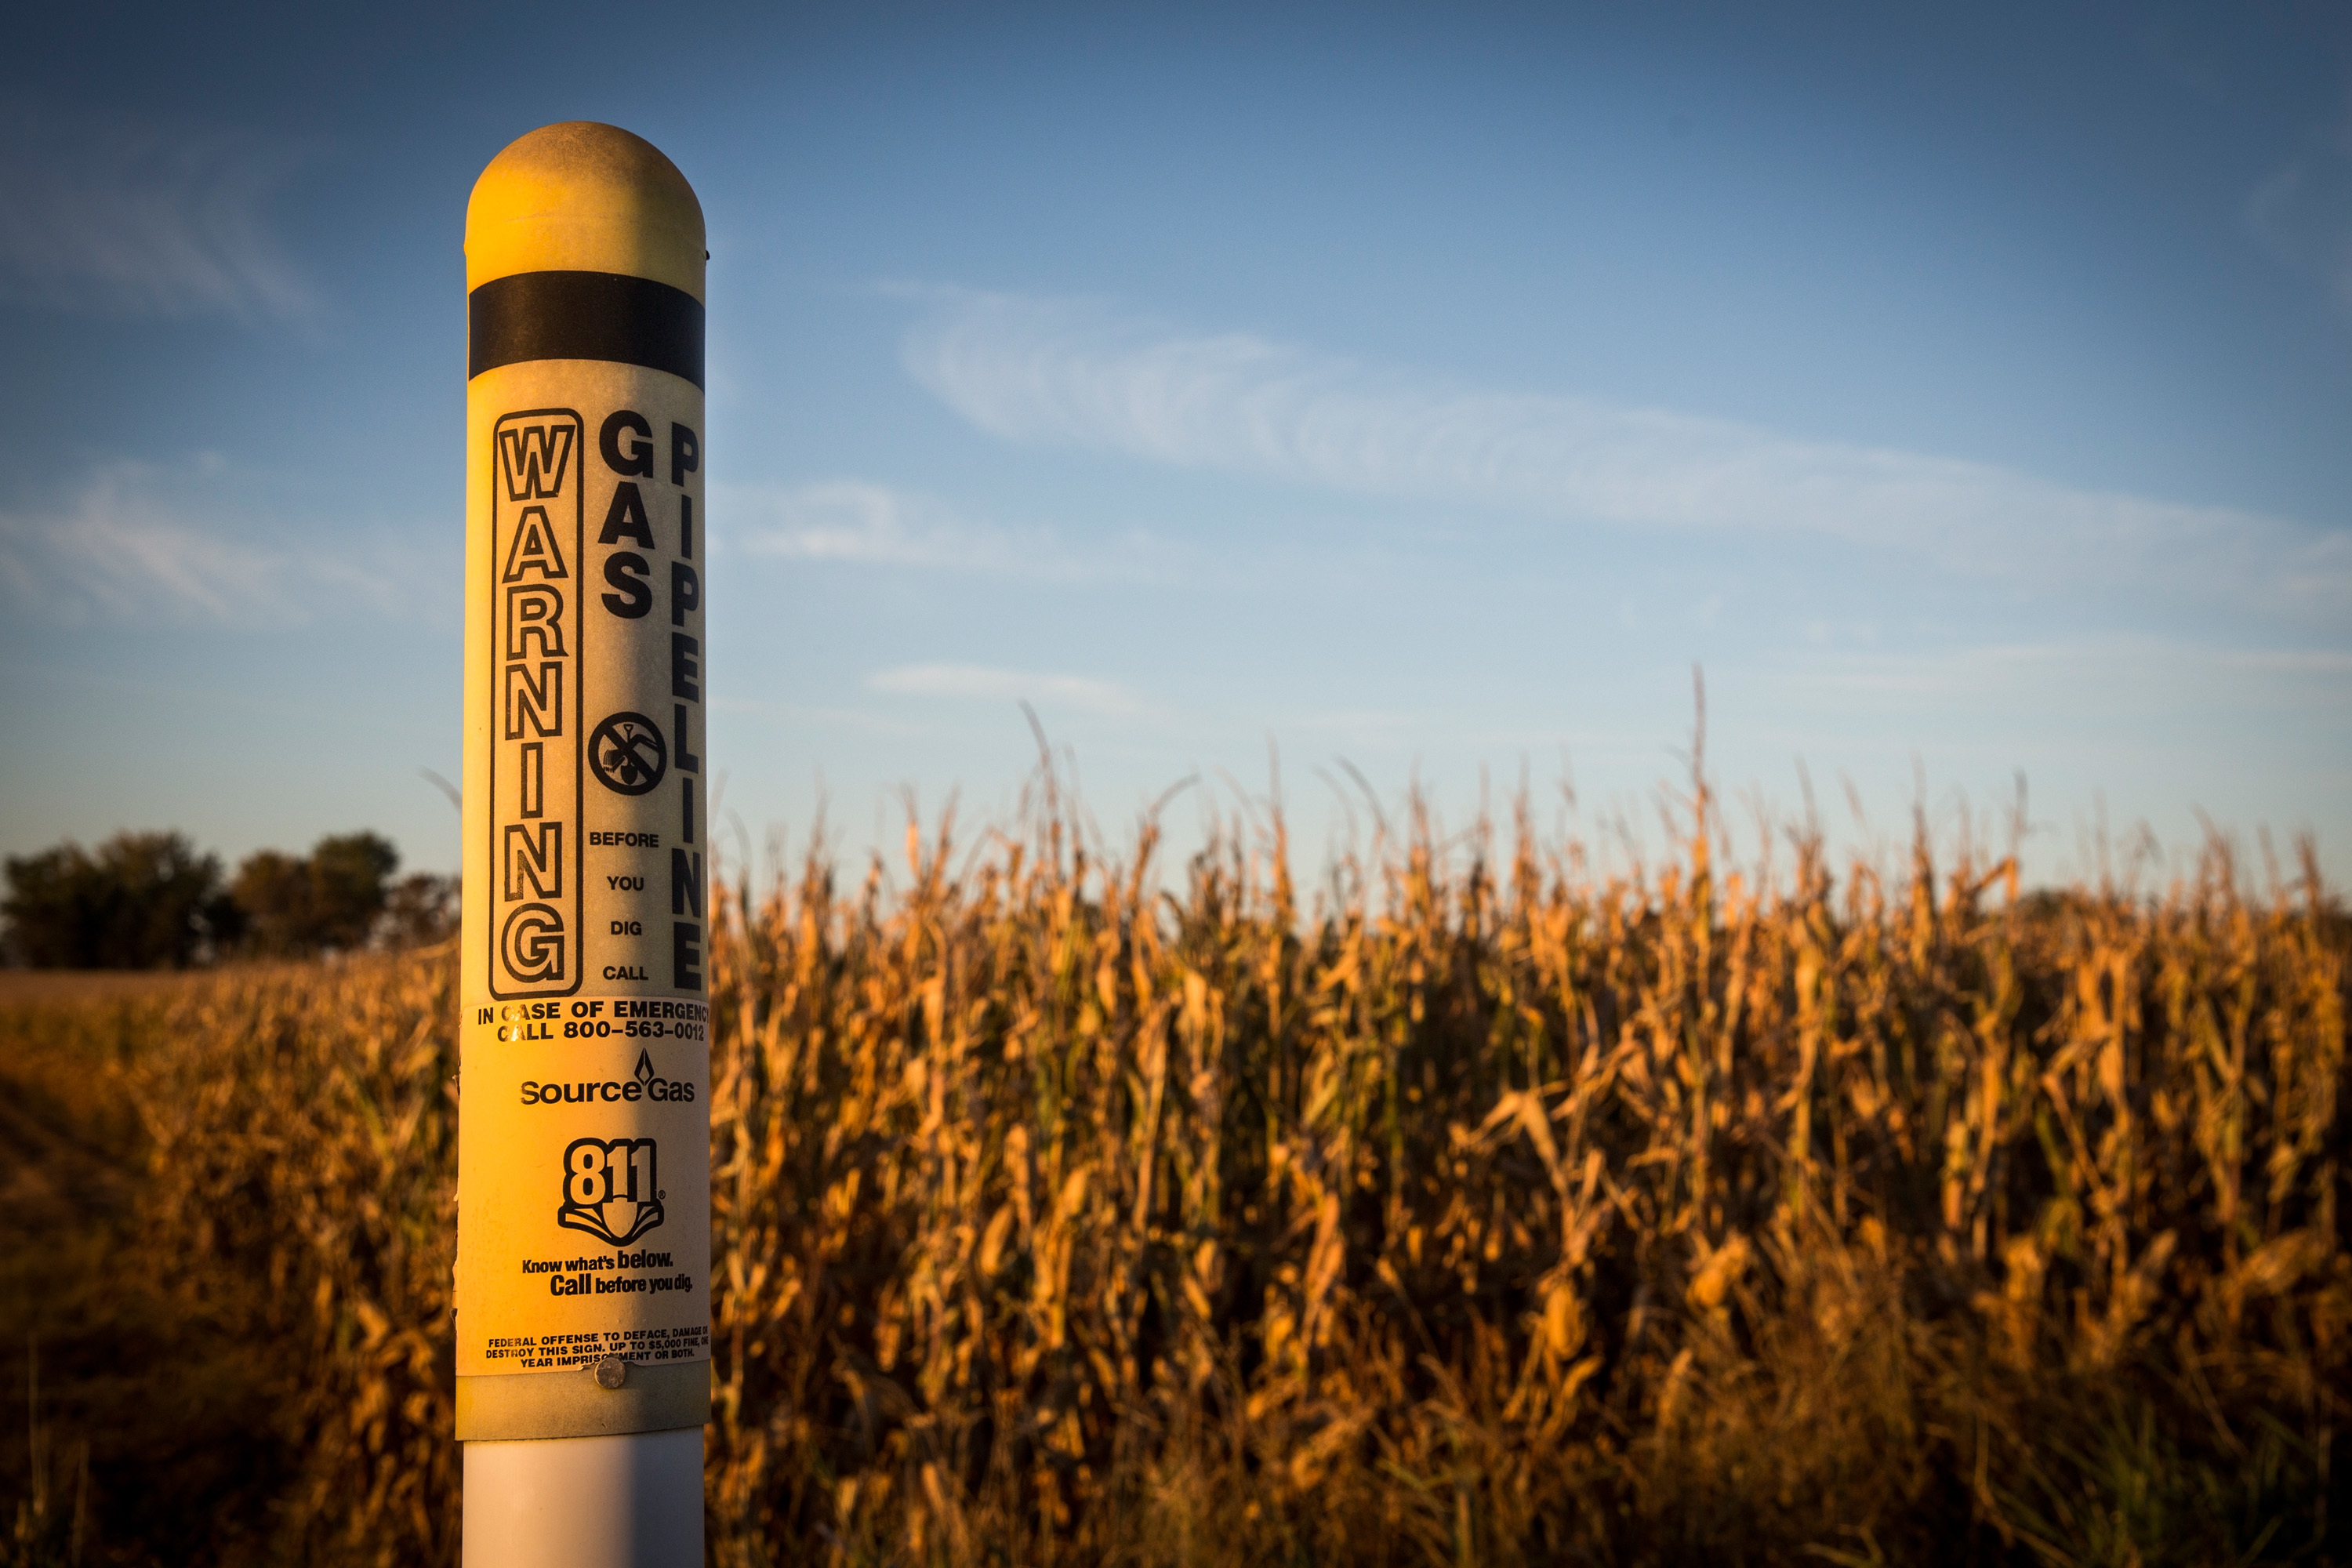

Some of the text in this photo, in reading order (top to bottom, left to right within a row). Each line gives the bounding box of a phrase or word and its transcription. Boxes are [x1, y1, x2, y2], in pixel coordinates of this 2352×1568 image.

[598, 409, 655, 619] GAS
[499, 424, 575, 983] WARNING
[671, 421, 702, 992] PIPELINE
[590, 832, 659, 848] BEFORE
[607, 876, 644, 891] YOU
[611, 921, 642, 935] DIG
[603, 966, 648, 981] CALL
[478, 1007, 494, 1025] IN
[501, 1002, 561, 1022] CASE
[571, 1000, 604, 1018] OF
[497, 1020, 704, 1042] CALL 800-563-0012
[568, 1142, 653, 1206] 811
[522, 1249, 673, 1274] Know what's below.
[550, 1273, 692, 1296] Call before you dig.
[486, 1348, 535, 1359] DESTROY
[539, 1345, 568, 1356] THIS
[572, 1343, 605, 1354] SIGN.
[609, 1341, 626, 1352] UP
[630, 1341, 645, 1350] TO
[648, 1339, 681, 1351] $5,000
[683, 1337, 700, 1348] FINE,
[488, 1337, 537, 1348] FEDERAL
[541, 1333, 598, 1345] OFFENSE
[603, 1332, 619, 1342] TO
[624, 1329, 670, 1341] DEFACE,
[673, 1326, 702, 1338] DAMAGE
[521, 1358, 553, 1367] YEAR
[655, 1351, 669, 1360] OR
[671, 1348, 695, 1359] BOTH.
